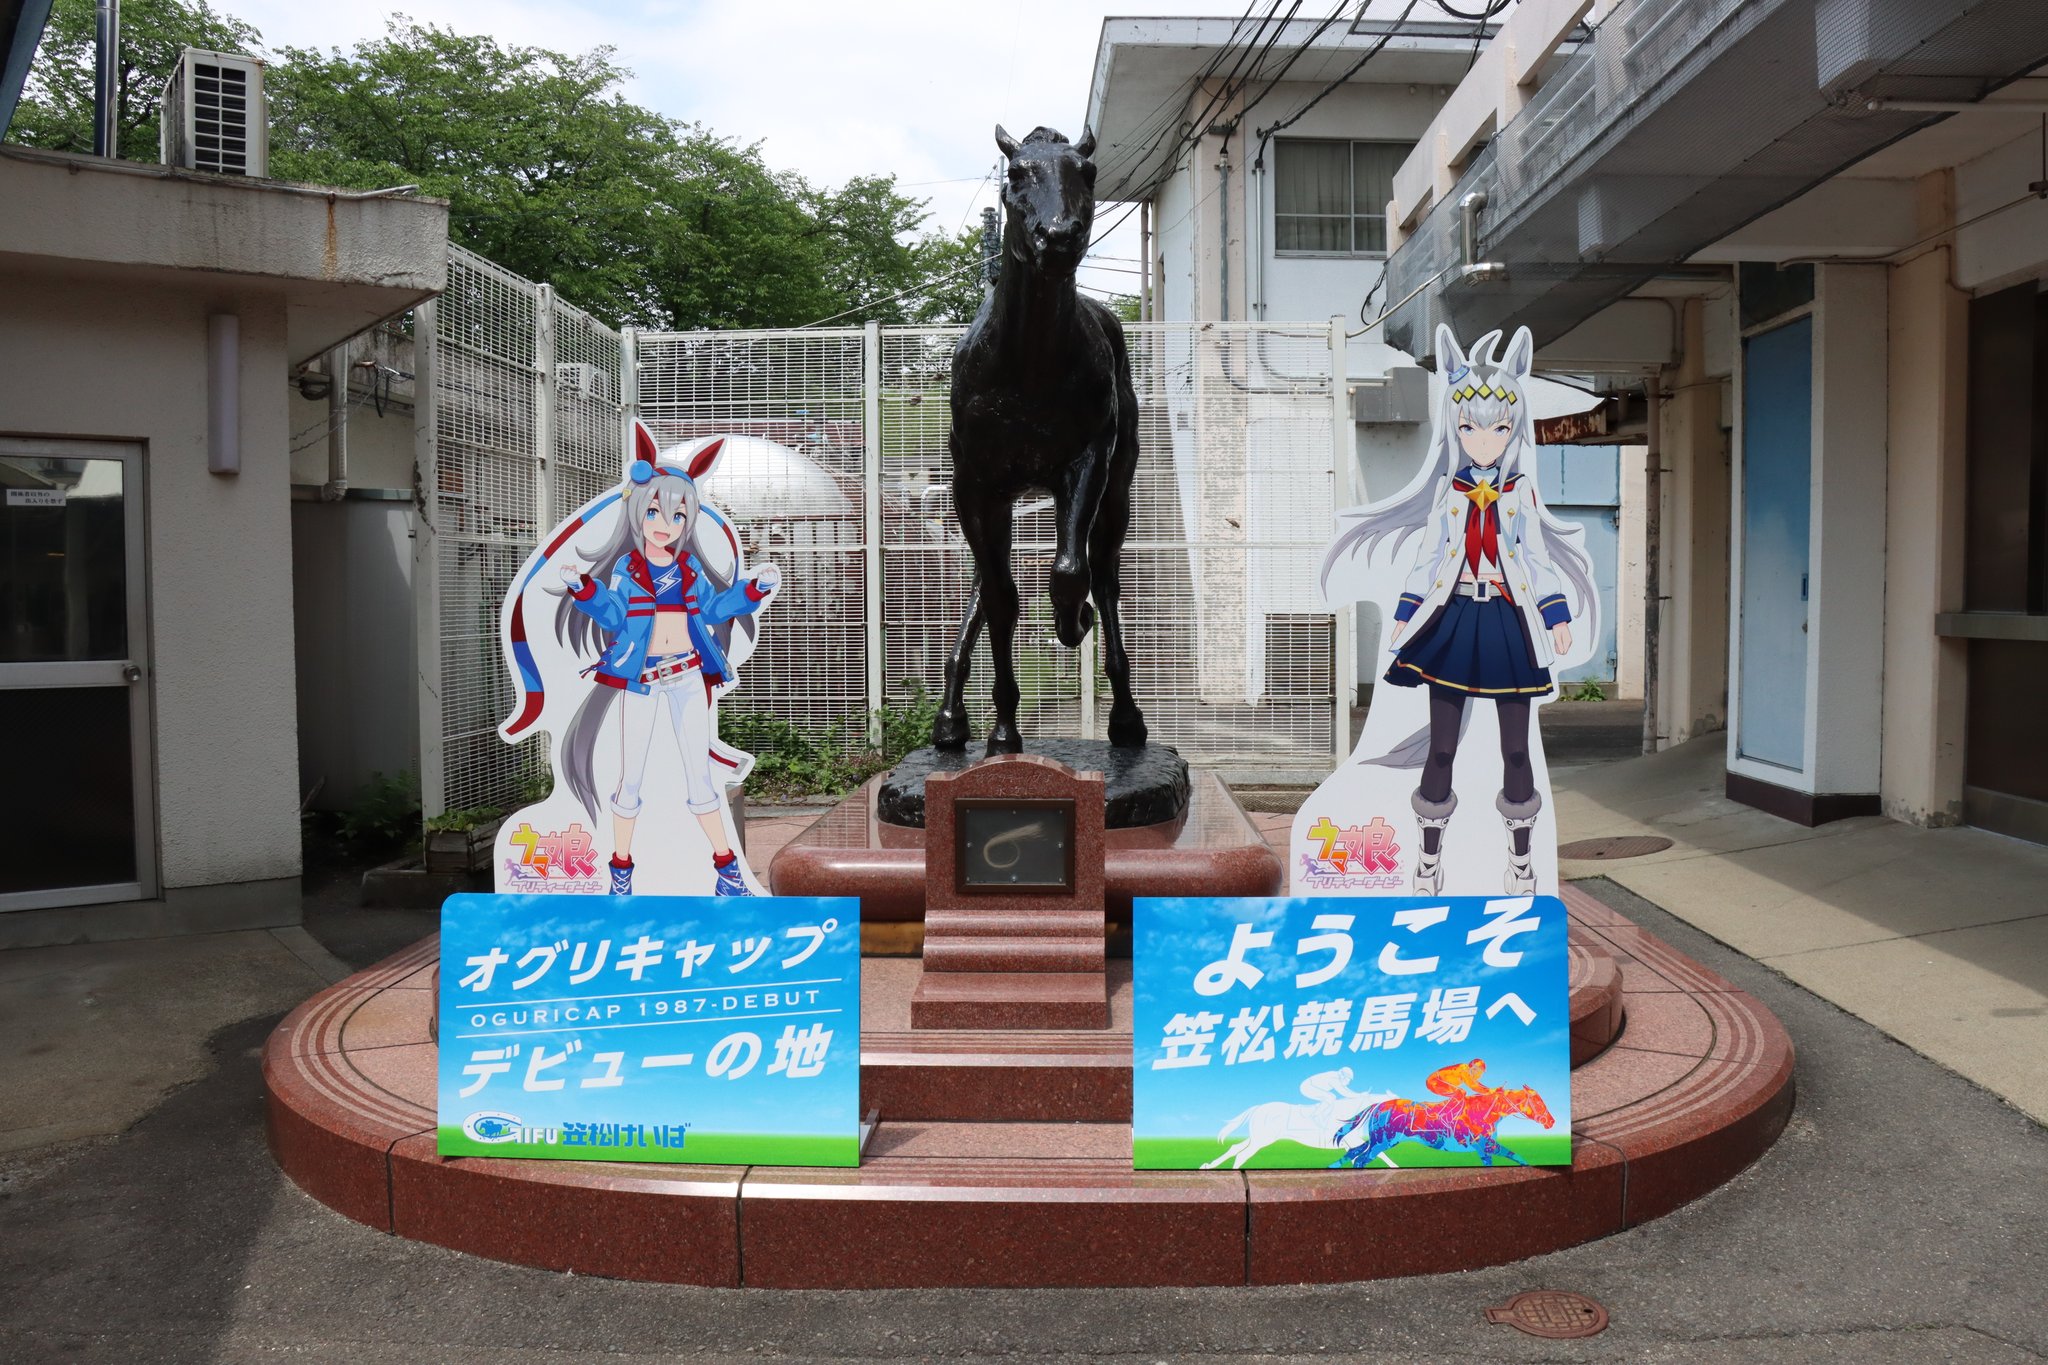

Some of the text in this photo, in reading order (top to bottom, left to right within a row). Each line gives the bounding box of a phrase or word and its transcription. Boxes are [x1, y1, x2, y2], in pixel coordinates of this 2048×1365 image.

[510, 823, 598, 880] ウマ娘
[1307, 816, 1401, 876] ウマ娘
[511, 881, 602, 893] プリティーダービー
[1306, 876, 1404, 889] プリティーダービー
[458, 918, 838, 992] オグリキャップ
[1193, 896, 1541, 996] ようこそ
[470, 989, 821, 1028] OGURICAP 1987-DEBUT
[1151, 985, 1538, 1070] 笠松競馬場へ
[459, 1023, 833, 1098] デビューの地
[562, 1121, 691, 1149] 笠松けいば
